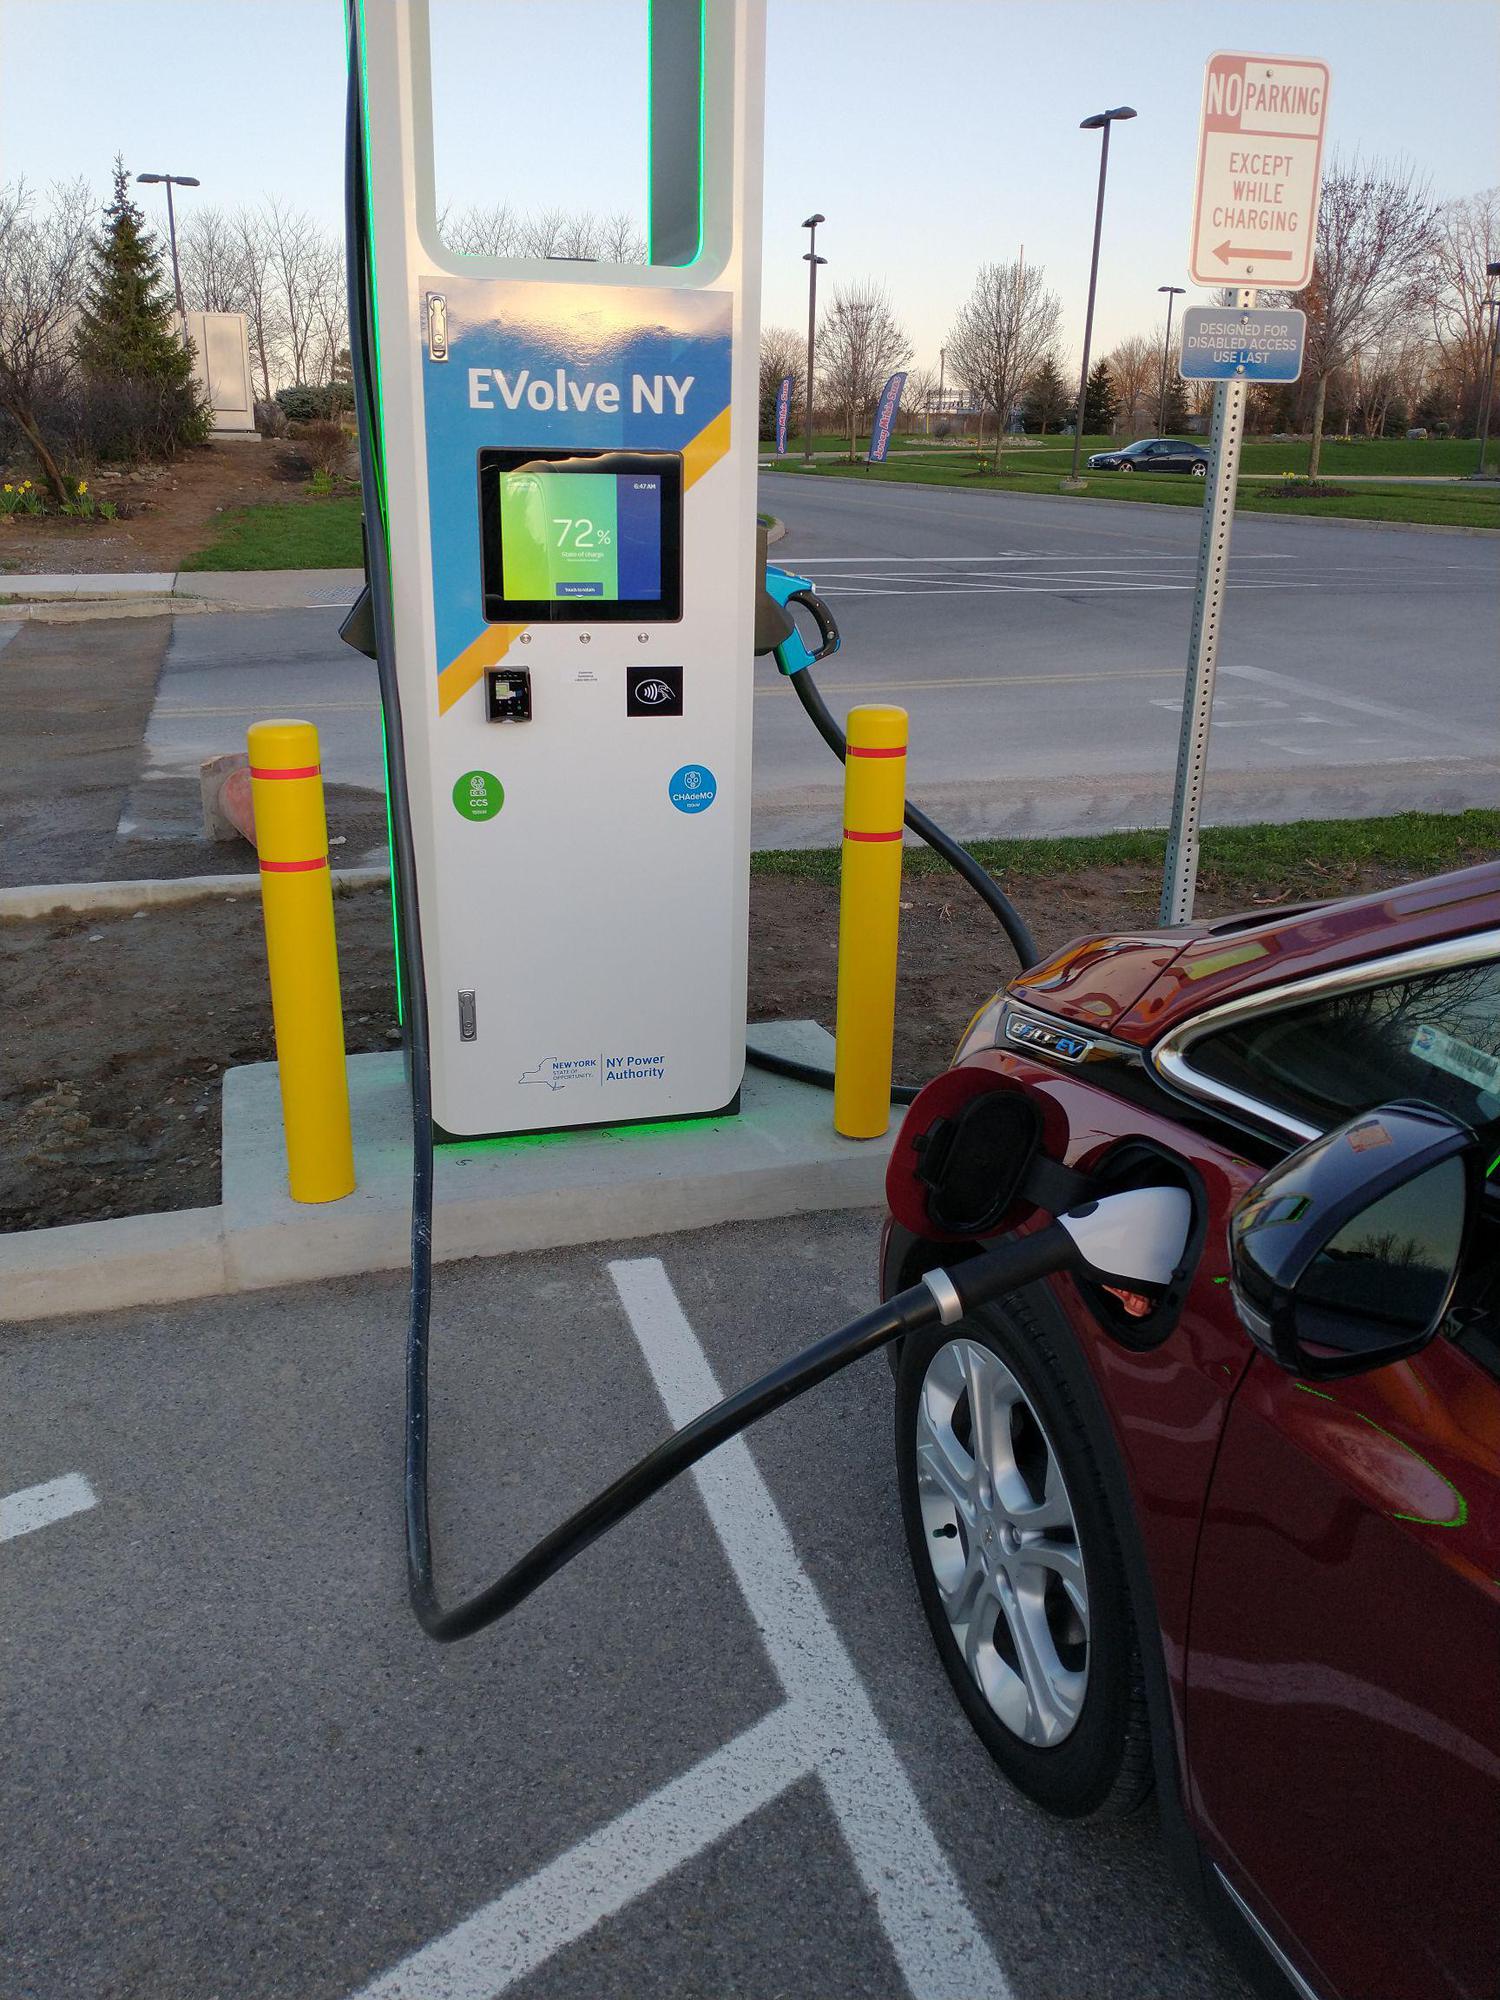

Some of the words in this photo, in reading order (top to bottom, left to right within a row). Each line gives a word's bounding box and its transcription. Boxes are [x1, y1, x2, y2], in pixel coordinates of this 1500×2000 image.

[1207, 73, 1242, 117] NO
[1245, 82, 1321, 116] PARKING
[1229, 152, 1293, 177] EXCEPT
[1233, 180, 1284, 204] WHILE
[1212, 207, 1298, 232] CHARGING
[1200, 322, 1260, 336] DESIGNED
[1264, 325, 1288, 337] FOR
[1188, 336, 1246, 349] DISABLED
[1249, 339, 1297, 351] ACCESS
[1213, 351, 1237, 363] USE
[1240, 352, 1270, 364] LAST
[467, 367, 620, 413] EVolve
[632, 374, 695, 415] NY
[469, 799, 488, 807] CCS
[672, 791, 714, 801] CHAdeMO
[1055, 1037, 1083, 1056] EV
[552, 1061, 571, 1070] NEW
[573, 1059, 597, 1068] YORK
[606, 1057, 624, 1068] NY
[627, 1055, 666, 1067] Power
[606, 1067, 665, 1082] Authority
